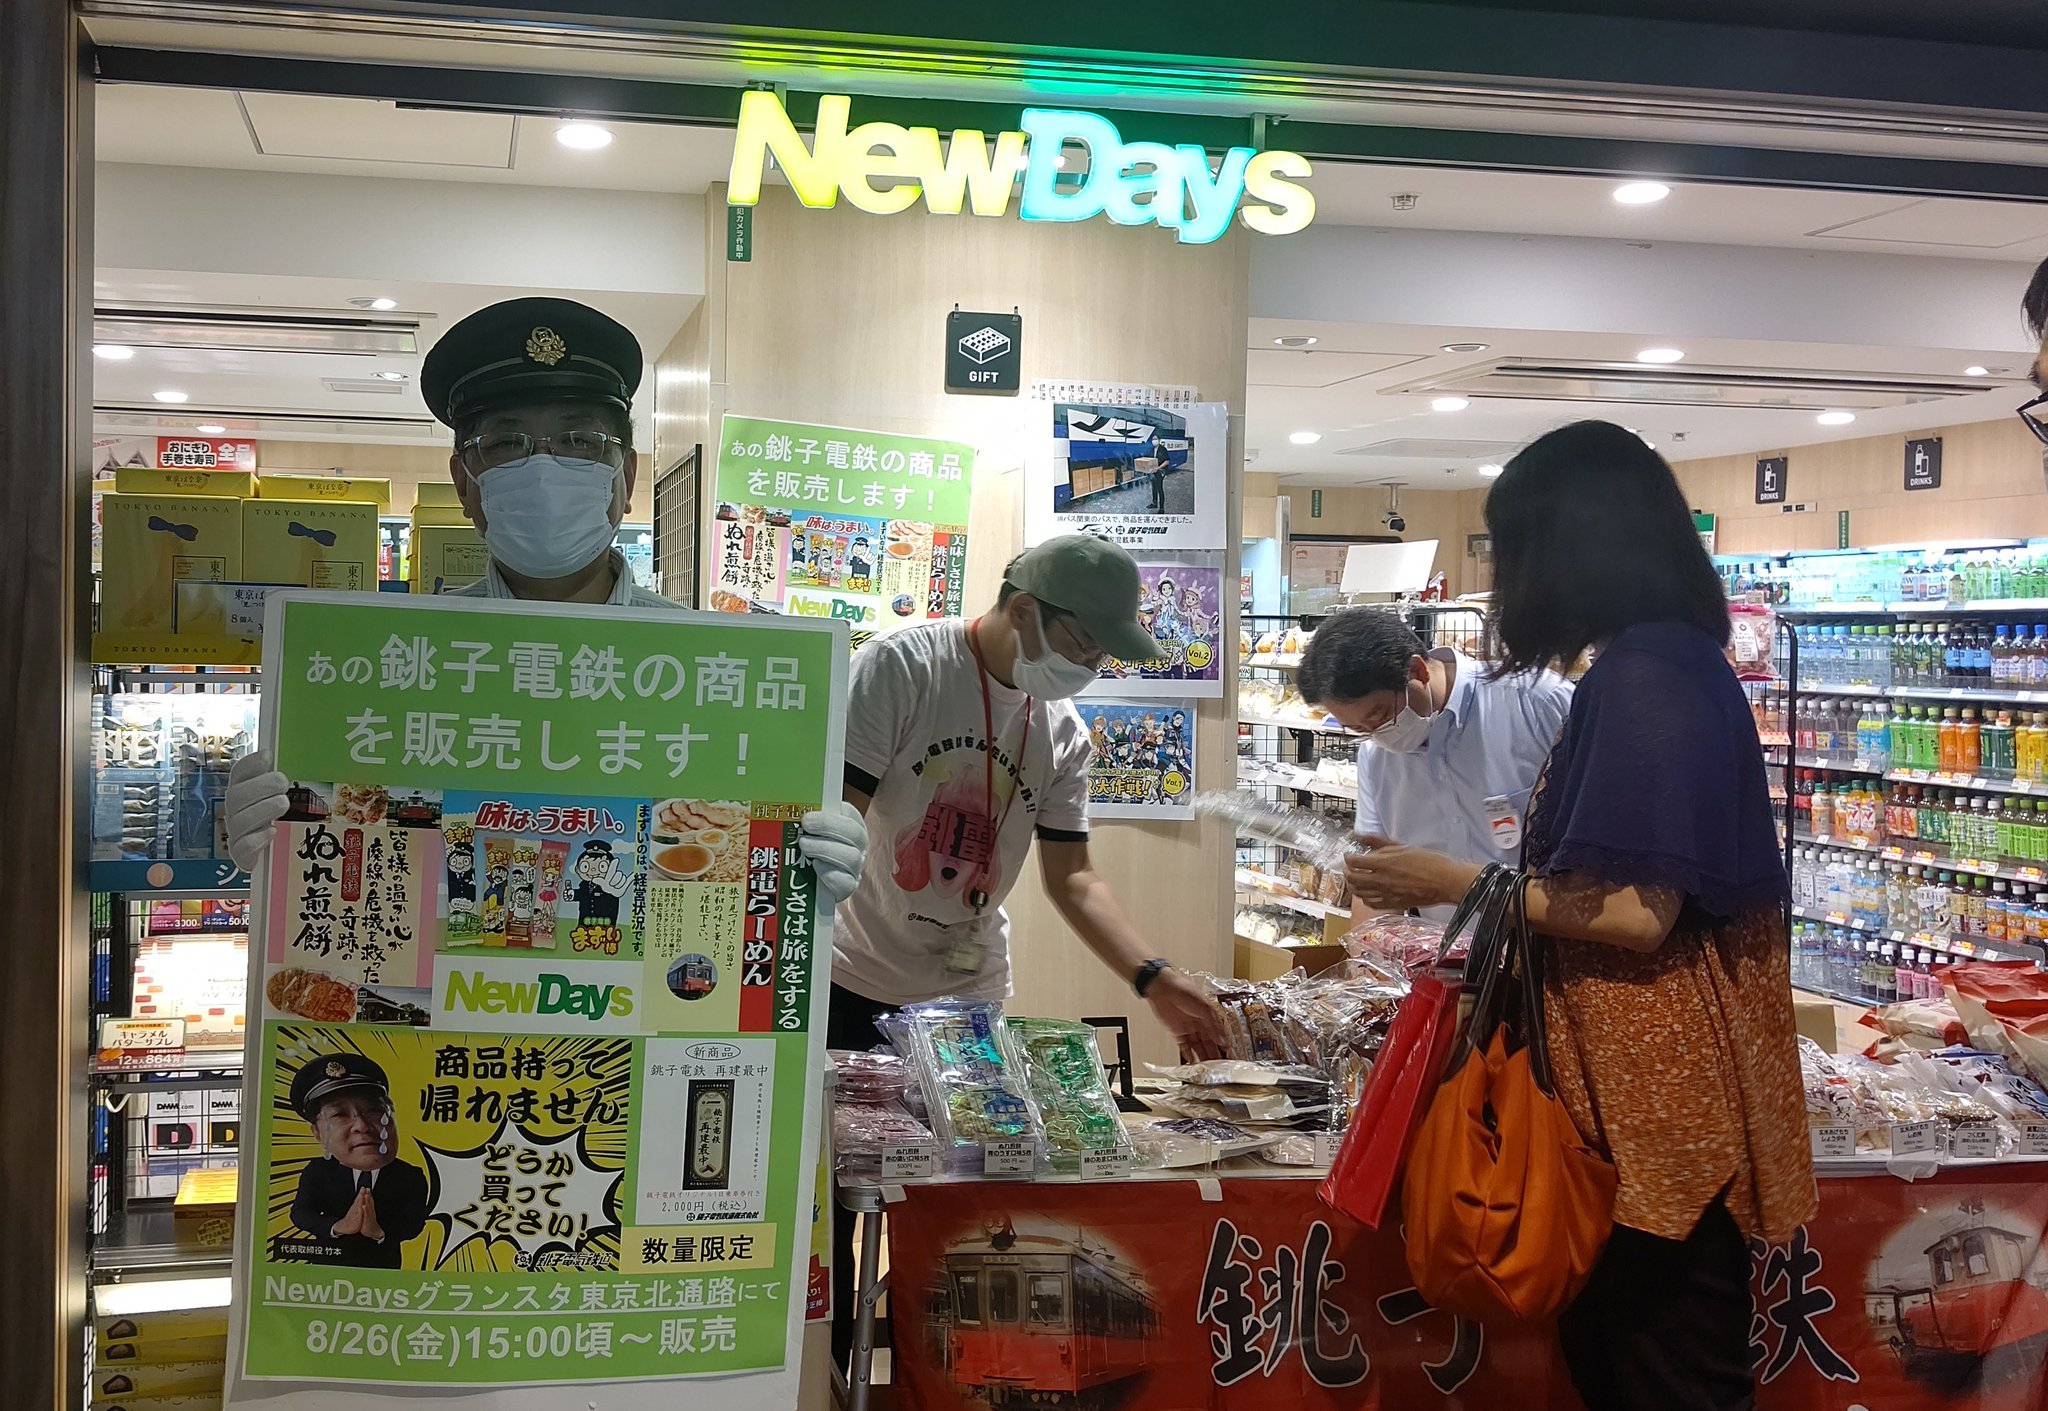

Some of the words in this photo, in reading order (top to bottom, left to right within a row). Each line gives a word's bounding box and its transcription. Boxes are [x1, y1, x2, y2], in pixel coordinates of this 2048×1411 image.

[728, 90, 1316, 244] NewDays
[968, 370, 1000, 384] GIFT
[162, 453, 217, 466] 手巻き寿司
[168, 442, 210, 455] おにぎり
[731, 433, 963, 481] あの銚子電鉄の商品
[747, 468, 935, 511] を販売します！
[1760, 492, 1779, 501] DRINKS
[1910, 477, 1933, 487] DRINKS
[114, 503, 161, 511] TOKYO
[171, 504, 230, 514] BANANA
[255, 509, 301, 517] TOKYO
[310, 511, 367, 519] BANANA
[806, 516, 875, 535] 味は、うまい。
[721, 523, 746, 586] ぬれ煎餅
[928, 545, 947, 613] 銚電らーめん
[945, 534, 966, 617] 美味しさは旅を
[788, 595, 877, 623] NewDays
[165, 646, 218, 654] BANANA
[1188, 649, 1210, 660] Vol.2
[306, 632, 808, 711] あの銚子電鉄の商品
[345, 706, 749, 778] を販売します！
[1165, 777, 1183, 788] Vol.1
[475, 800, 625, 835] 味は、うまい。
[292, 824, 347, 958] ぬれ煎餅
[386, 829, 413, 951] 皆様の温かい心が
[630, 804, 651, 957] まずいのは、経営状況です。
[360, 836, 386, 984] 廃線の危機を救った
[742, 847, 779, 987] 銚電らーめん
[336, 906, 361, 961] 奇跡の
[444, 970, 634, 1020] NewDays
[112, 1038, 173, 1047] バターサブレ
[120, 1030, 168, 1039] キャラメル
[693, 1045, 734, 1059] 新商品
[434, 1044, 611, 1080] 商品持って
[650, 1064, 706, 1077] 銚子電鉄
[714, 1064, 769, 1077] 再建最中
[420, 1084, 621, 1125] 帰れません
[483, 1143, 575, 1178] どうか
[480, 1174, 567, 1207] 買って
[453, 1204, 588, 1241] ください!
[280, 1244, 323, 1255] 代表取締役
[324, 1246, 342, 1256] 竹本
[536, 1251, 613, 1268] 銚子電気鉄道
[641, 1234, 754, 1264] 数量限定
[263, 1275, 783, 1313] NewDaysグランスタ東京北通路にて
[305, 1314, 738, 1366] 8/26(金)15:00頃～販売
